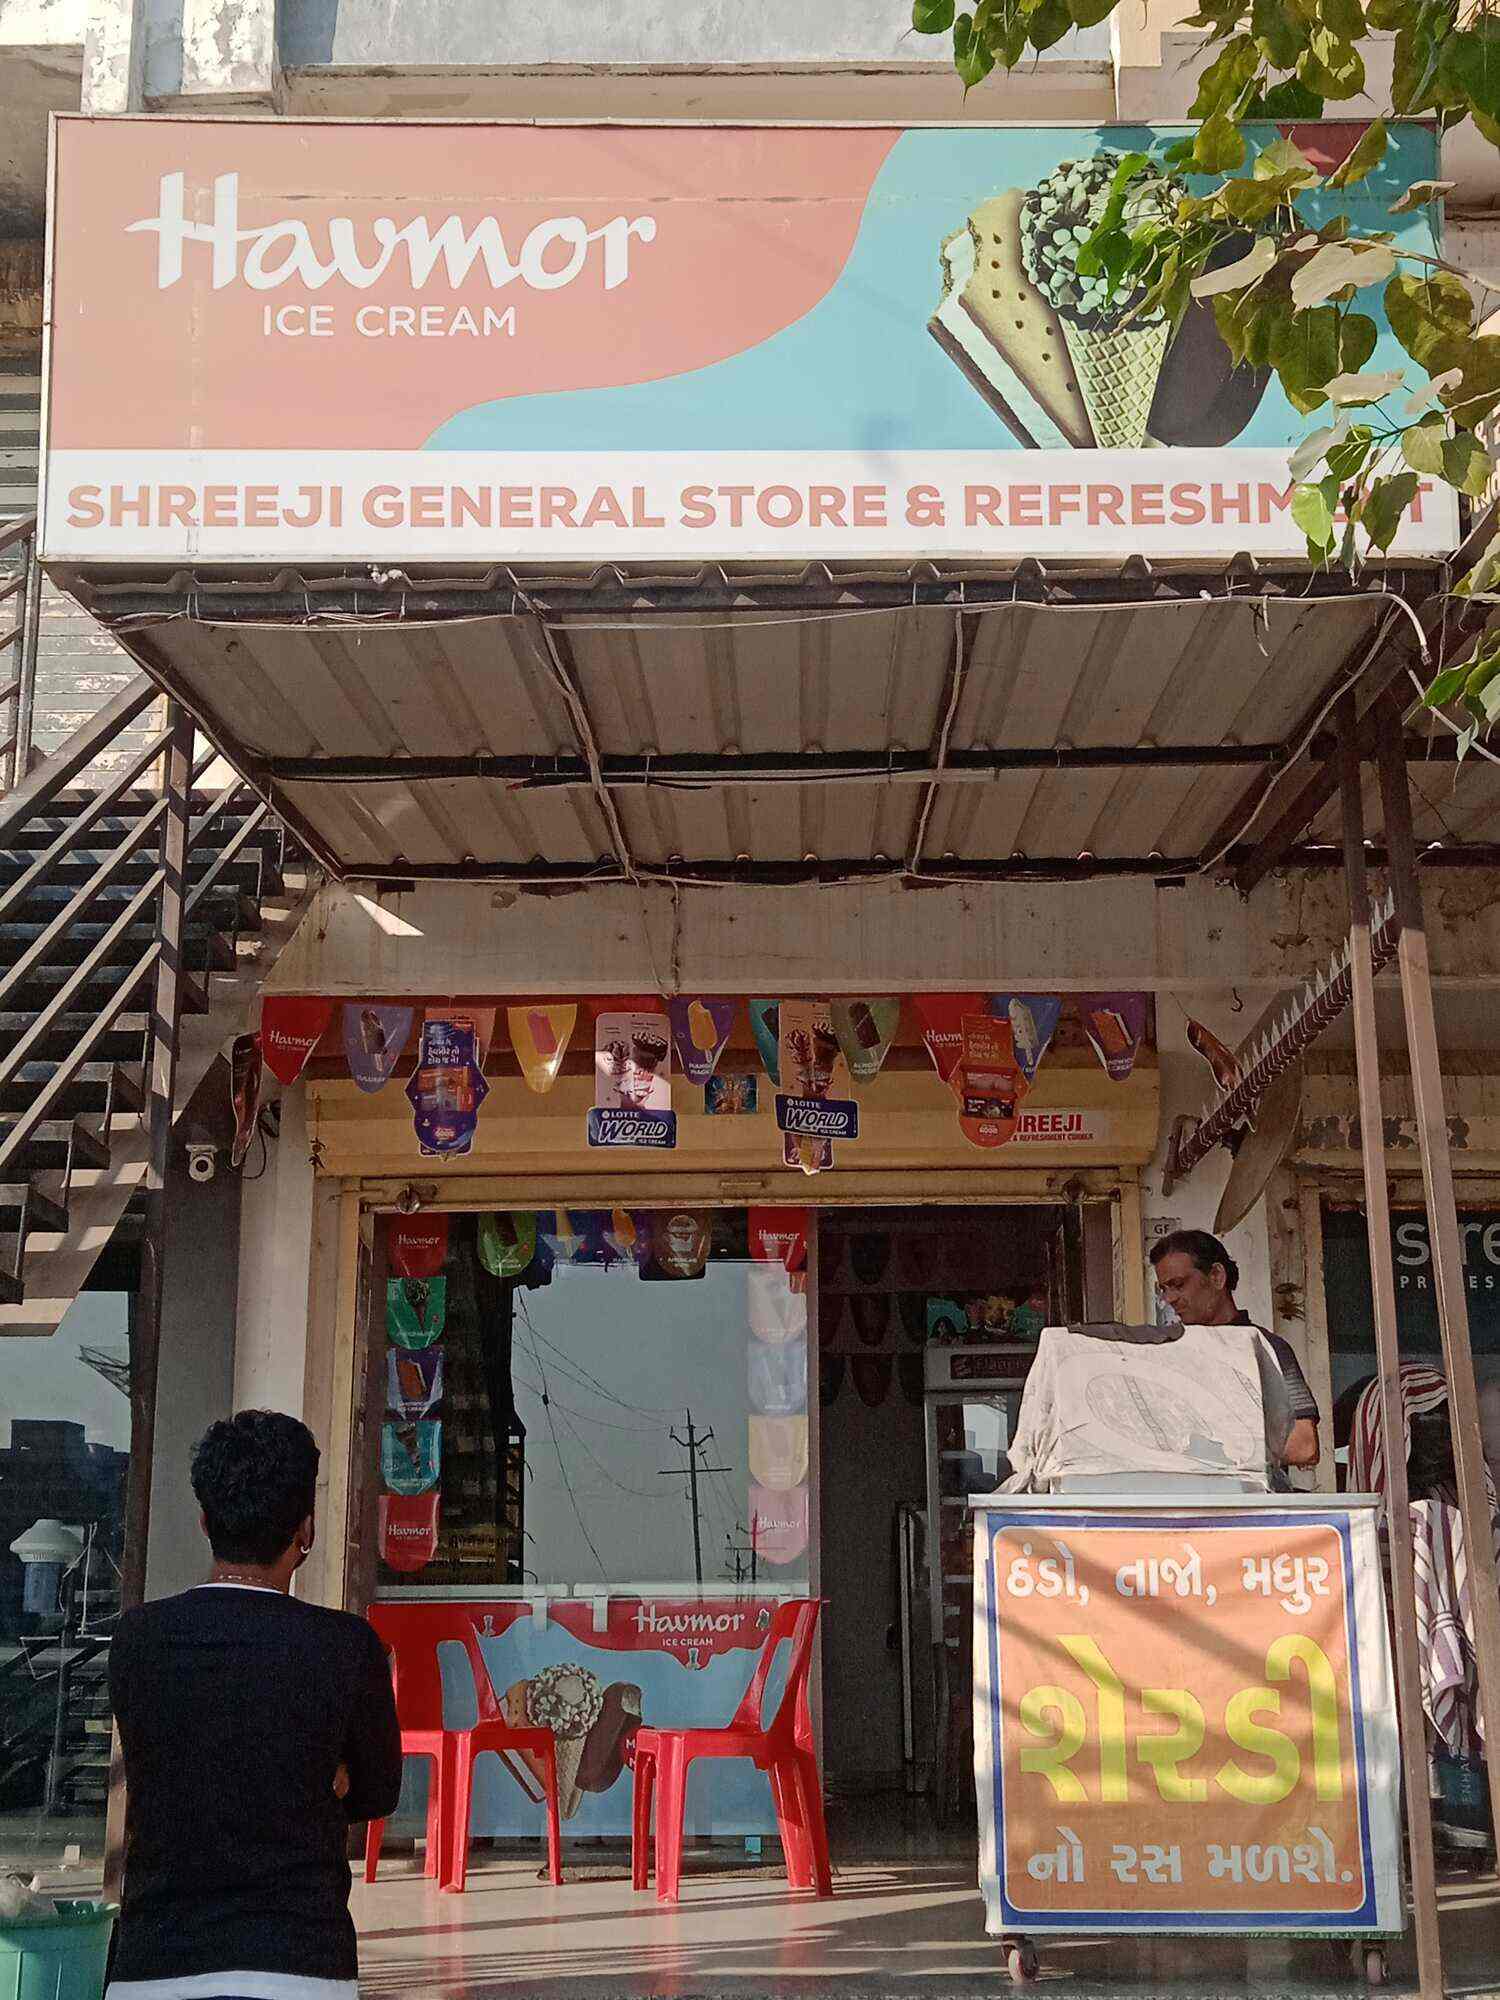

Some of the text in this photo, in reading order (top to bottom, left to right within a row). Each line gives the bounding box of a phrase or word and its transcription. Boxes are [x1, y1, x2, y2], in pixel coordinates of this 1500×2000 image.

[124, 172, 656, 290] Havmor
[263, 305, 517, 337] ICE CREAM
[65, 482, 1434, 529] SHREEJI GENERAL STORE & REFRESHMT
[926, 1030, 963, 1042] Havm
[786, 1107, 848, 1130] WORLD
[1016, 1114, 1082, 1133] REEJI
[598, 1120, 669, 1144] WORLD
[1400, 1275, 1494, 1289] PRES
[388, 1524, 432, 1536] Havmor
[1006, 1541, 1331, 1615] ઠંડો, તાજો, મધુર
[631, 1605, 745, 1633] Havmor
[662, 1638, 714, 1647] ICE CREAM
[1020, 1633, 1343, 1804] શેરડી
[1027, 1826, 1354, 1884] નો રસ મળશે.
